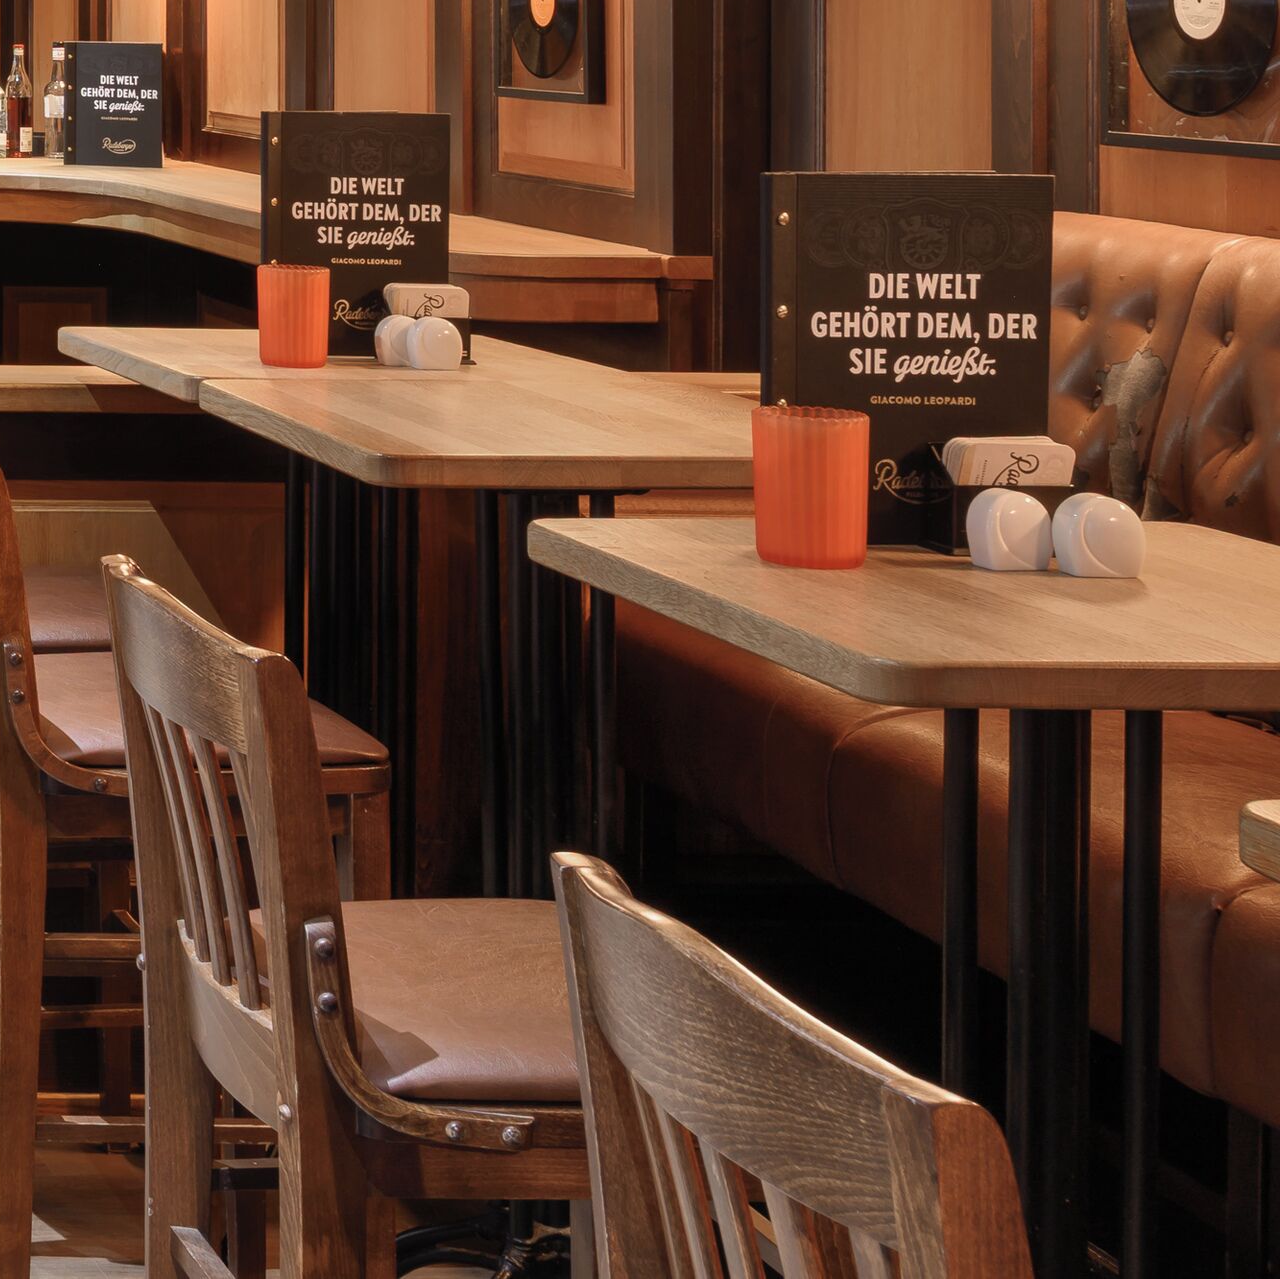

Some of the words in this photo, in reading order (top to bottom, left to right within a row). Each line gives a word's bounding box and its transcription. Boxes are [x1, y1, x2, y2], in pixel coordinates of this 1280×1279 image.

[100, 75, 115, 85] DIE
[116, 75, 139, 86] WELT
[81, 86, 114, 98] GEHÖRT
[141, 89, 158, 100] DER
[94, 100, 107, 110] SIE
[330, 176, 358, 195] DIE
[361, 177, 405, 196] WELT
[291, 198, 359, 220] GEHÖRT
[362, 203, 405, 225] DEM,
[409, 204, 442, 222] DER
[317, 226, 343, 244] SIE
[346, 225, 416, 251] genießt.
[331, 257, 366, 265] GIACOMO
[366, 258, 402, 266] LEOPARDI
[869, 273, 909, 300] DIE
[915, 273, 981, 300] WELT
[810, 306, 911, 339] GEHÖRT
[917, 312, 980, 344] DEM,
[988, 313, 1038, 339] DER
[848, 348, 887, 375] SIE
[893, 346, 997, 384] genießt.
[869, 395, 922, 406] GIACOMO
[924, 396, 977, 406] LEOPARDI
